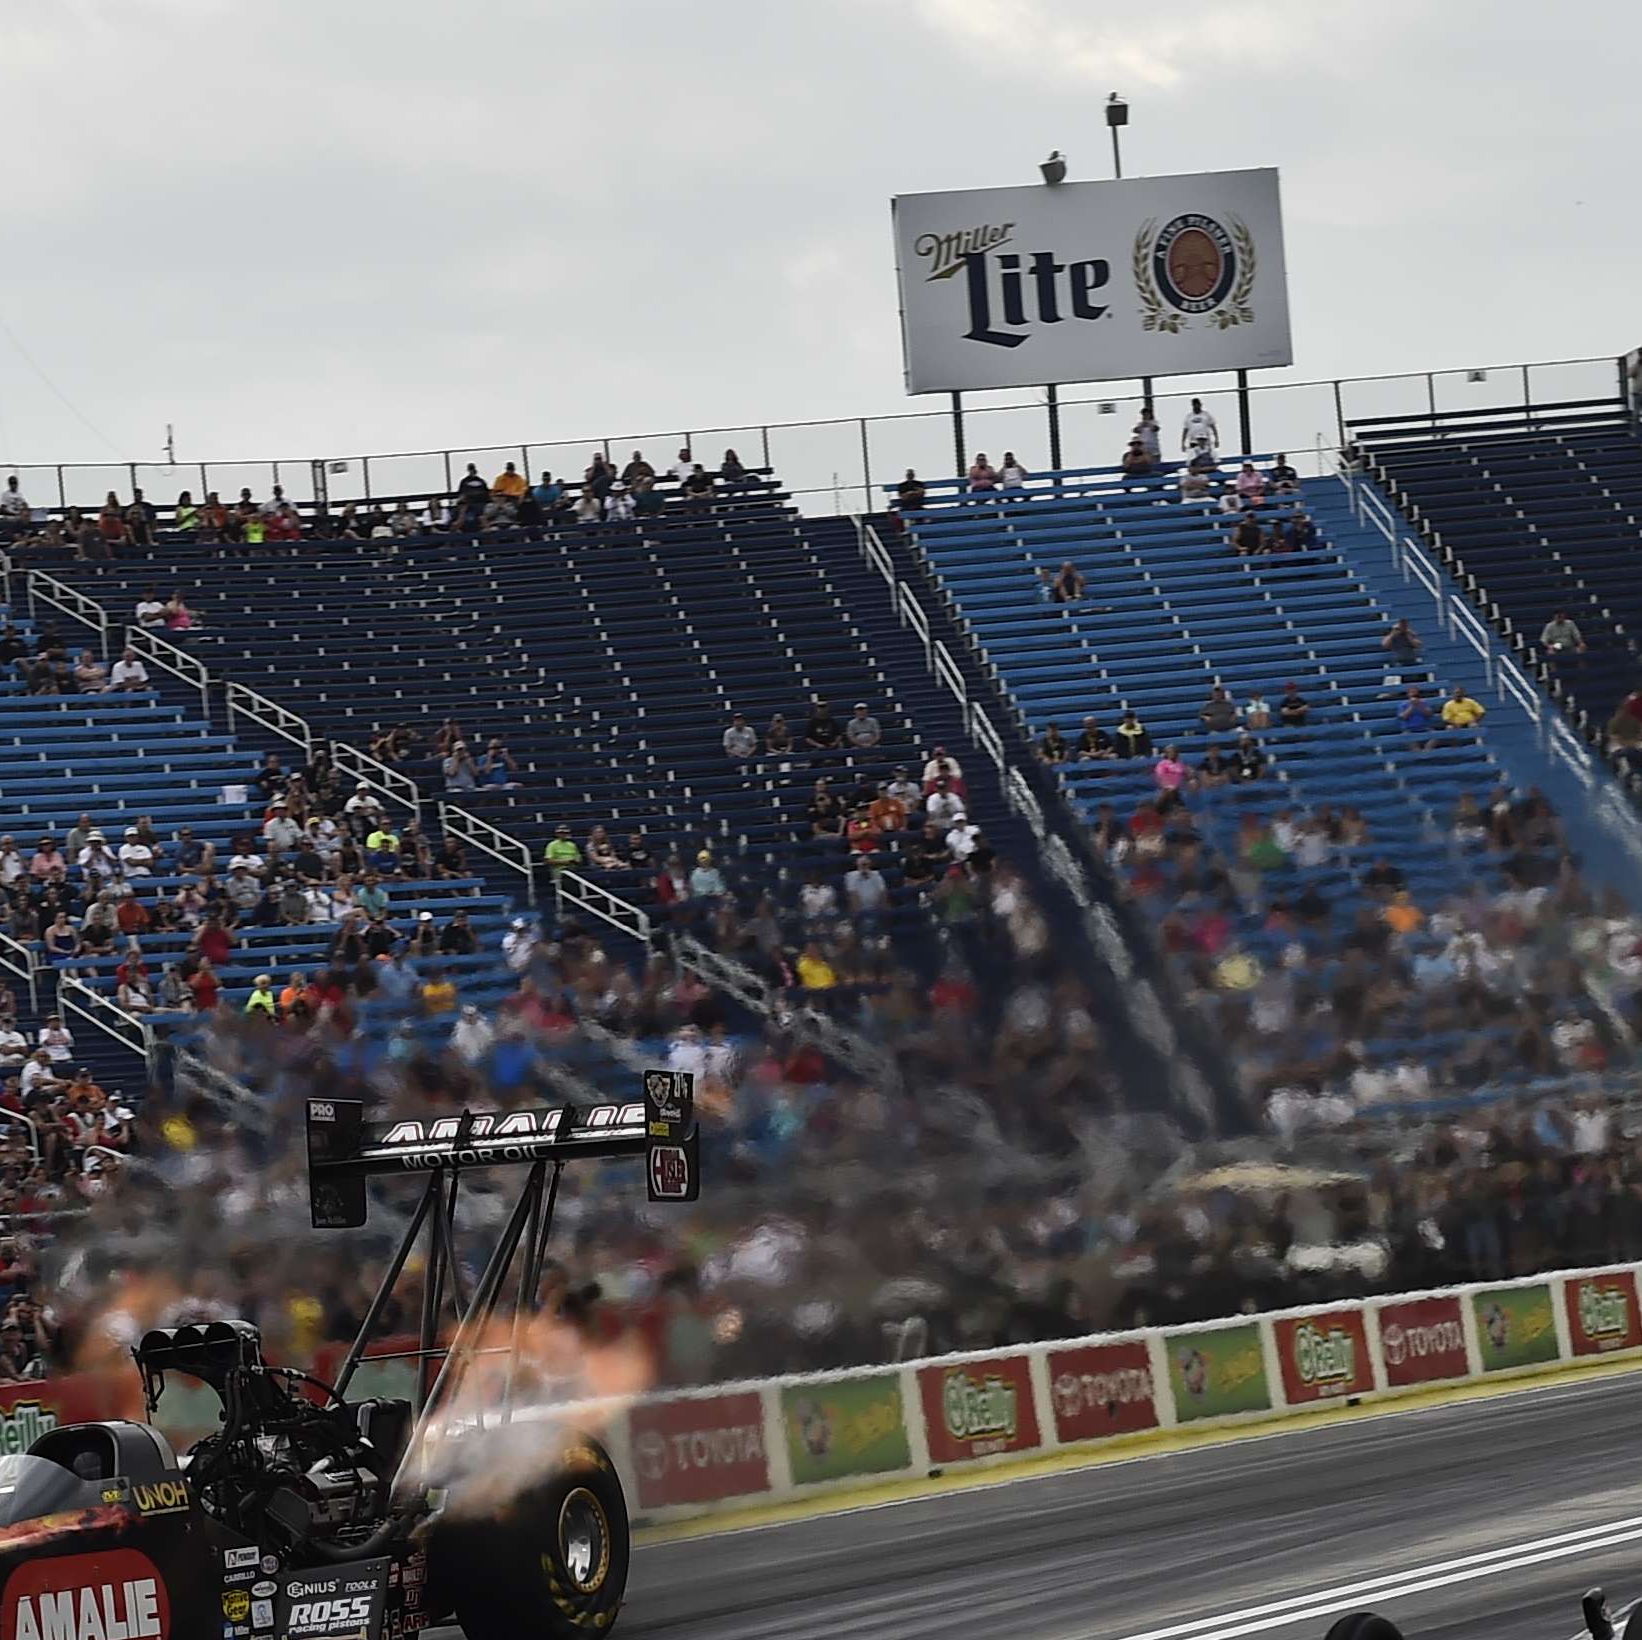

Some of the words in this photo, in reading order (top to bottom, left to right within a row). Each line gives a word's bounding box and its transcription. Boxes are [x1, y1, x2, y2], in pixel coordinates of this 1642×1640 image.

[915, 224, 1015, 273] Miller
[957, 252, 1110, 348] Lite
[310, 1103, 335, 1117] PRO
[402, 1148, 495, 1170] MOTOR
[504, 1145, 550, 1161] OIL
[133, 1480, 190, 1511] UNOH
[345, 1580, 378, 1593] TOOLS
[288, 1596, 372, 1626] ROSS
[289, 1622, 327, 1635] racing
[327, 1617, 371, 1632] pistons
